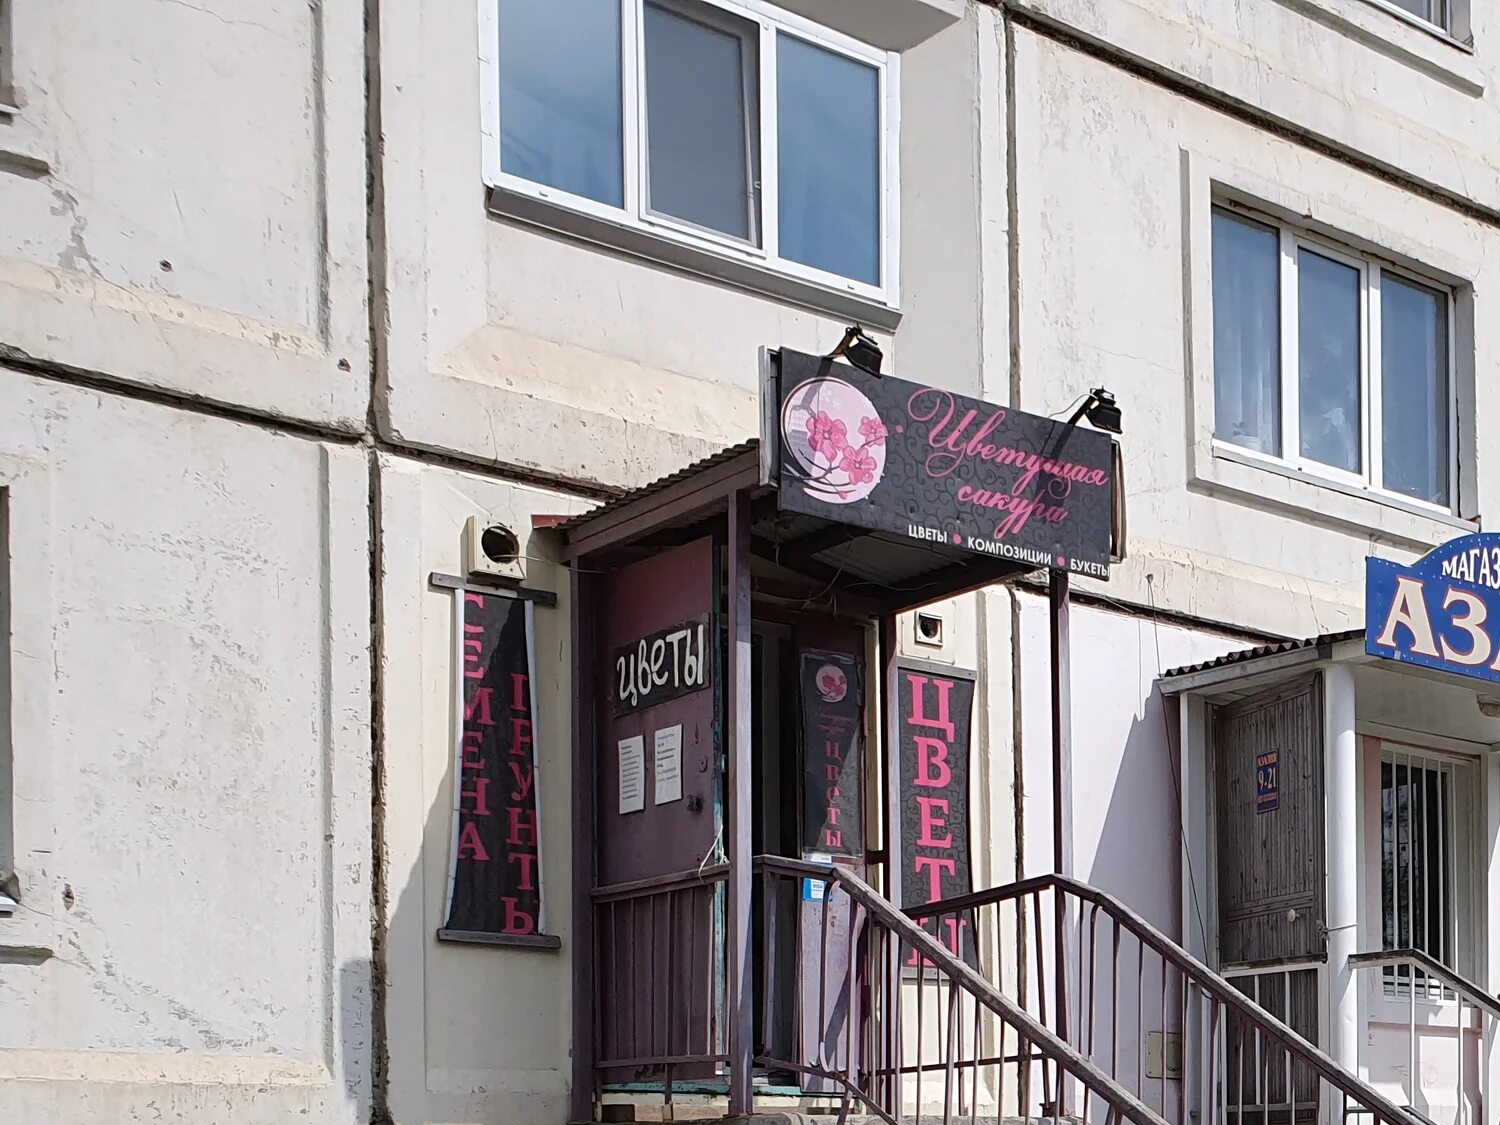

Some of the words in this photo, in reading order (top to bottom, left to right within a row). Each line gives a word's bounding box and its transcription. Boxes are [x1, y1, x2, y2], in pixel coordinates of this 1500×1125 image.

[907, 386, 1110, 499] Цветущая
[958, 485, 1068, 539] сакура
[908, 523, 948, 544] ЦВЕТЫ
[967, 536, 1052, 567] КОМПОЗИЦИИ
[1070, 557, 1111, 578] БУКЕТЫ
